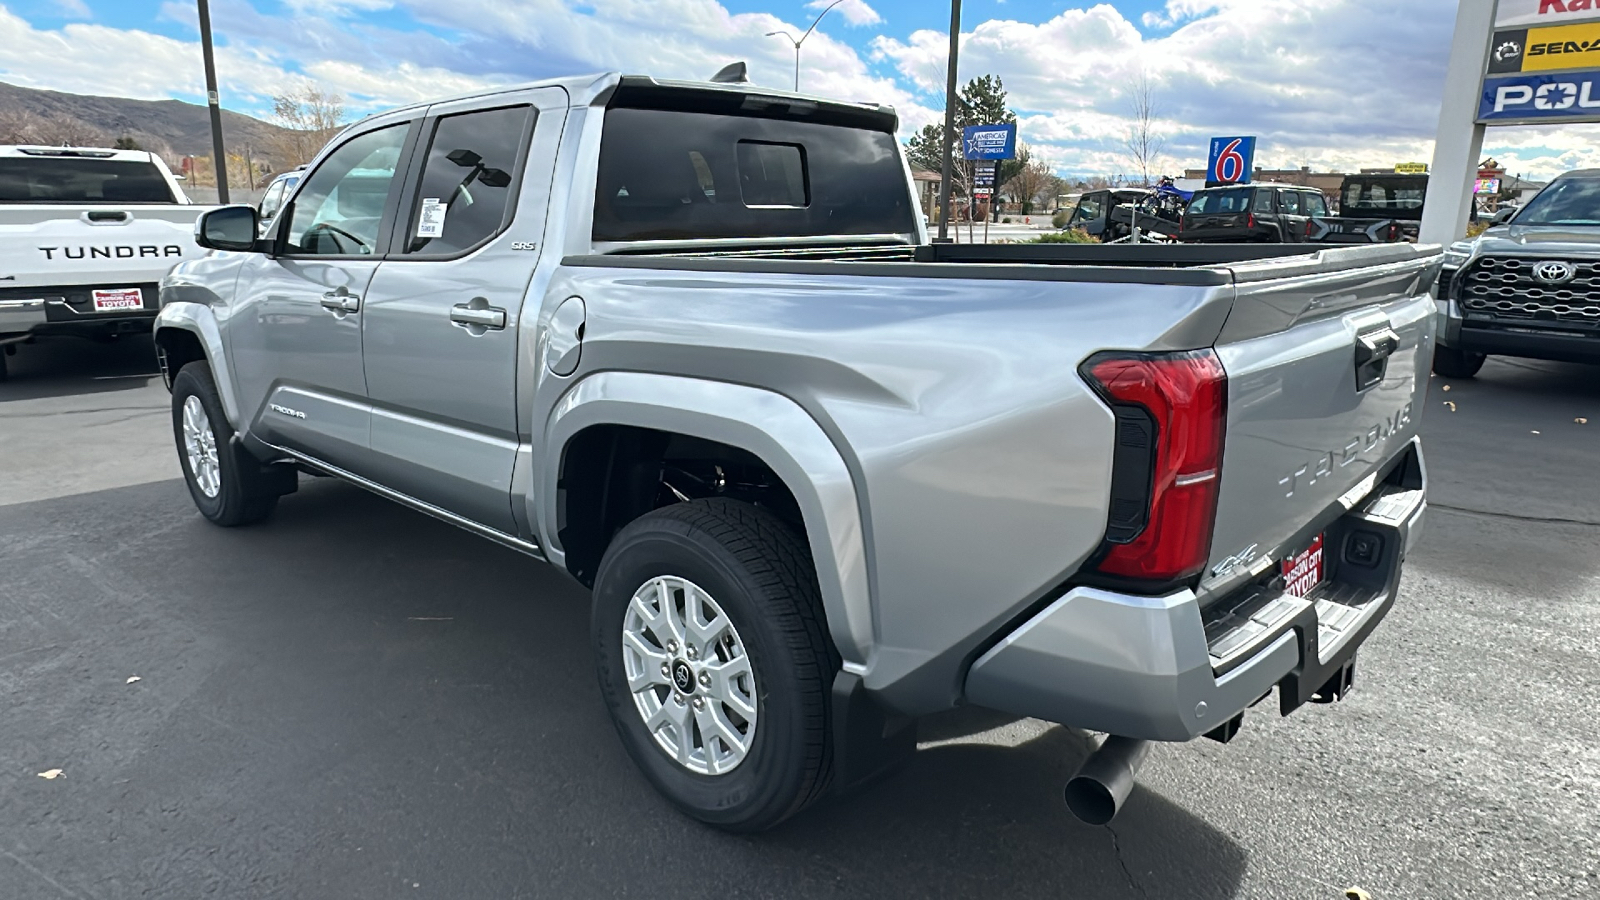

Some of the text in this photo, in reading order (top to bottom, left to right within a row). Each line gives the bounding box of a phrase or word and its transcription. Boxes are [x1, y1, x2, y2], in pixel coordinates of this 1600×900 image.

[1215, 138, 1244, 182] 6
[38, 245, 182, 260] TUNDRA
[101, 299, 136, 307] TOYOTA
[270, 403, 306, 419] TACOMA
[1279, 401, 1412, 497] TACOMA
[1308, 547, 1323, 569] CITY
